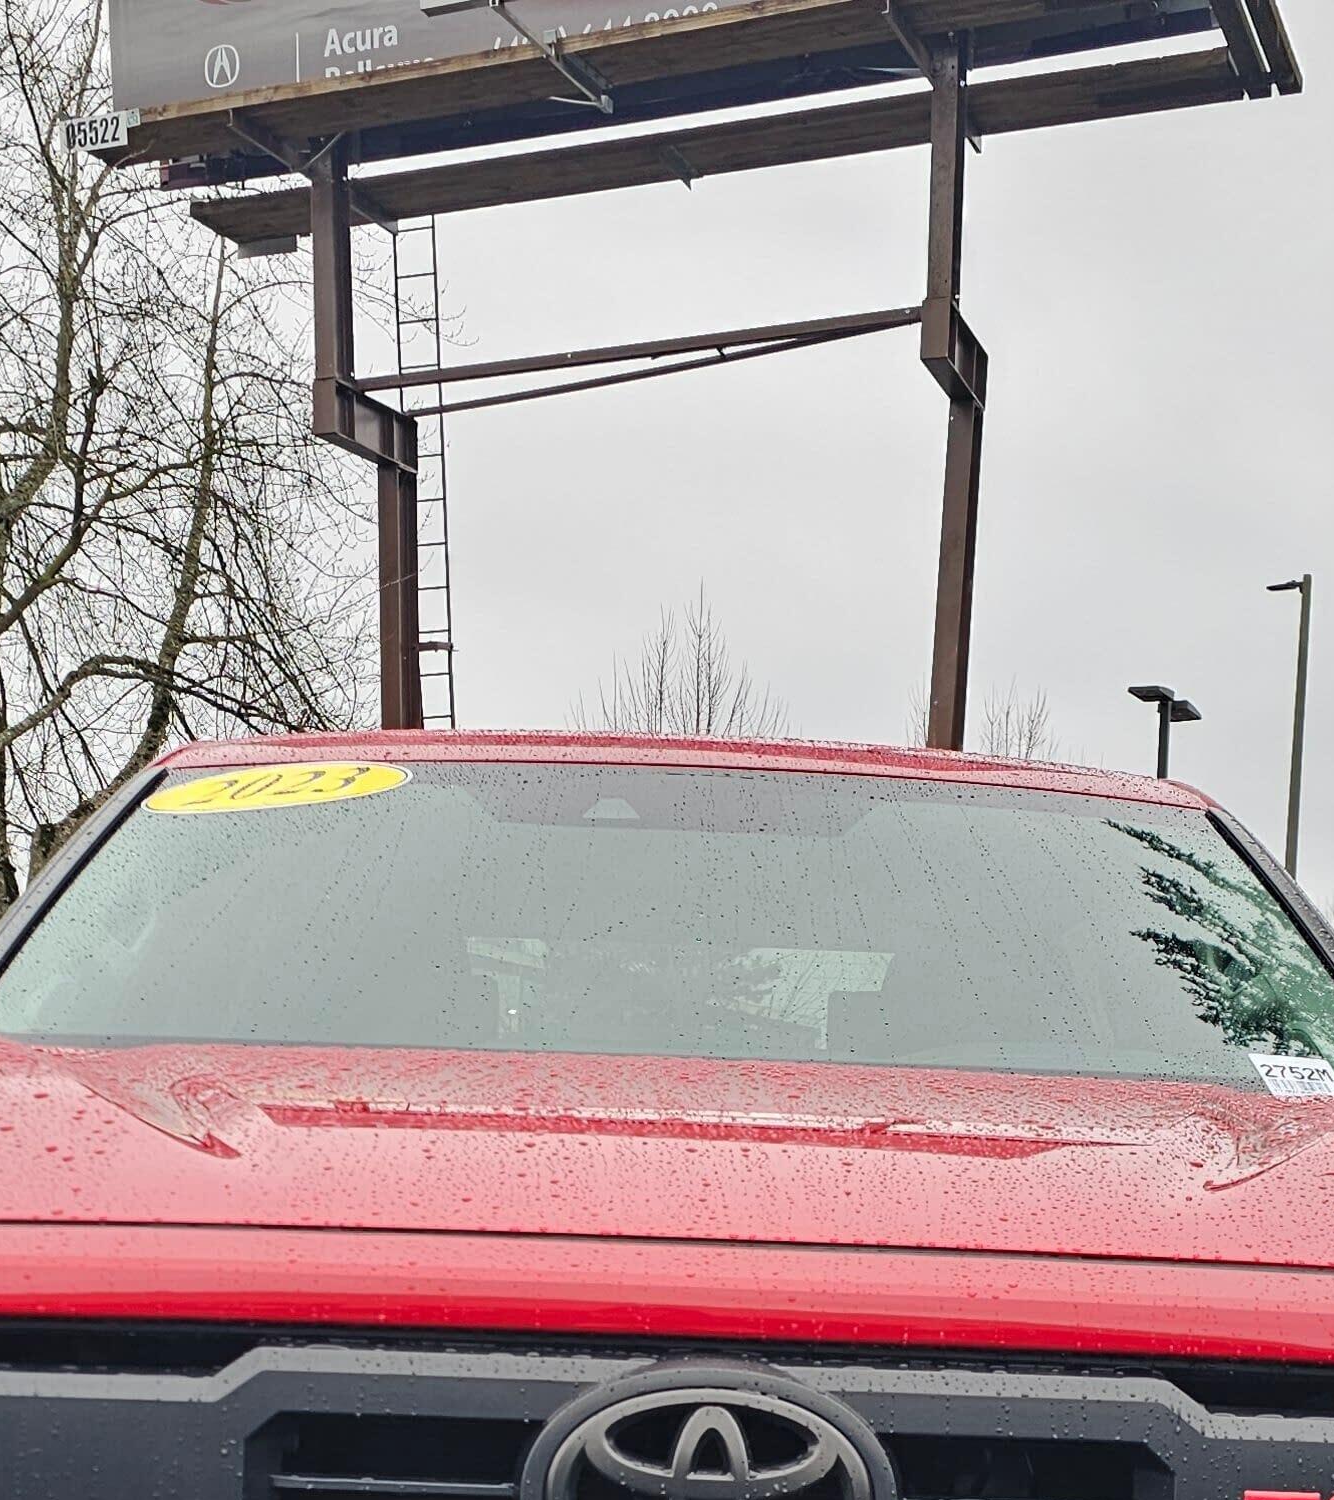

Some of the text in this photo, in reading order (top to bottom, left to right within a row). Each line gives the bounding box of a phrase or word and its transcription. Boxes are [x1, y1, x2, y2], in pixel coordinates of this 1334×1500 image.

[323, 24, 398, 57] Acura
[180, 766, 370, 806] 2023
[1260, 1064, 1334, 1082] 2752M
